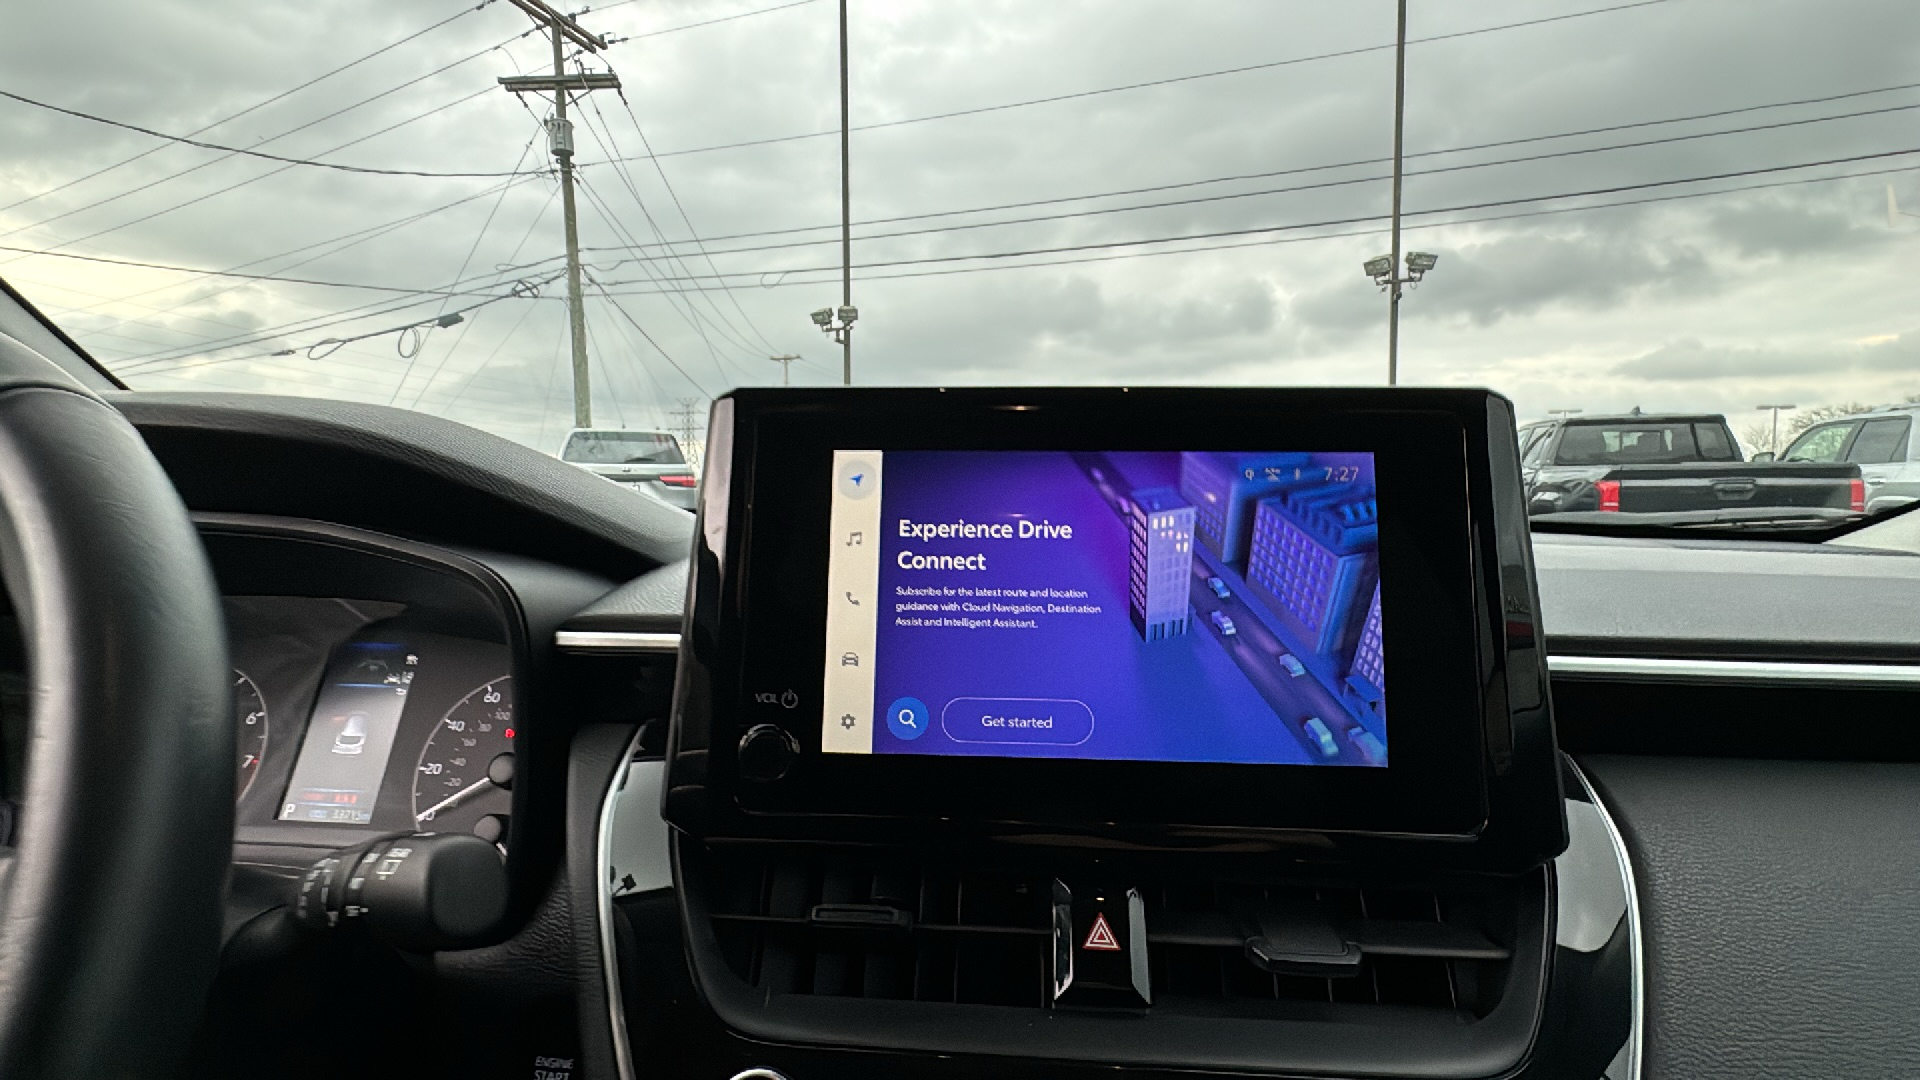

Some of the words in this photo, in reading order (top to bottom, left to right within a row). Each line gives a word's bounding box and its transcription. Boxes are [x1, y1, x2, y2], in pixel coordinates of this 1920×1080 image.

[1323, 466, 1359, 482] 7:27
[899, 519, 1014, 542] Experience
[1018, 520, 1073, 539] Drive
[897, 551, 987, 571] Connect
[895, 586, 942, 598] Subscribe
[943, 586, 957, 597] for
[958, 587, 974, 597] the
[975, 587, 1001, 598] latest
[1003, 588, 1028, 598] route
[1029, 588, 1048, 599] and
[1050, 588, 1088, 599] location
[895, 602, 939, 614] guidance
[940, 602, 961, 612] with
[962, 602, 991, 613] Cloud
[992, 603, 1046, 615] Navigation,
[1047, 603, 1102, 614] Destination
[895, 617, 922, 627] Assist
[923, 617, 942, 627] and
[943, 617, 991, 629] Intelligent
[993, 618, 1039, 629] Assistant.
[483, 692, 501, 703] 60
[245, 711, 257, 725] 6
[981, 715, 1005, 728] Get
[1007, 716, 1053, 729] started
[242, 754, 255, 769] 7
[424, 763, 443, 775] 20
[283, 803, 296, 819] P
